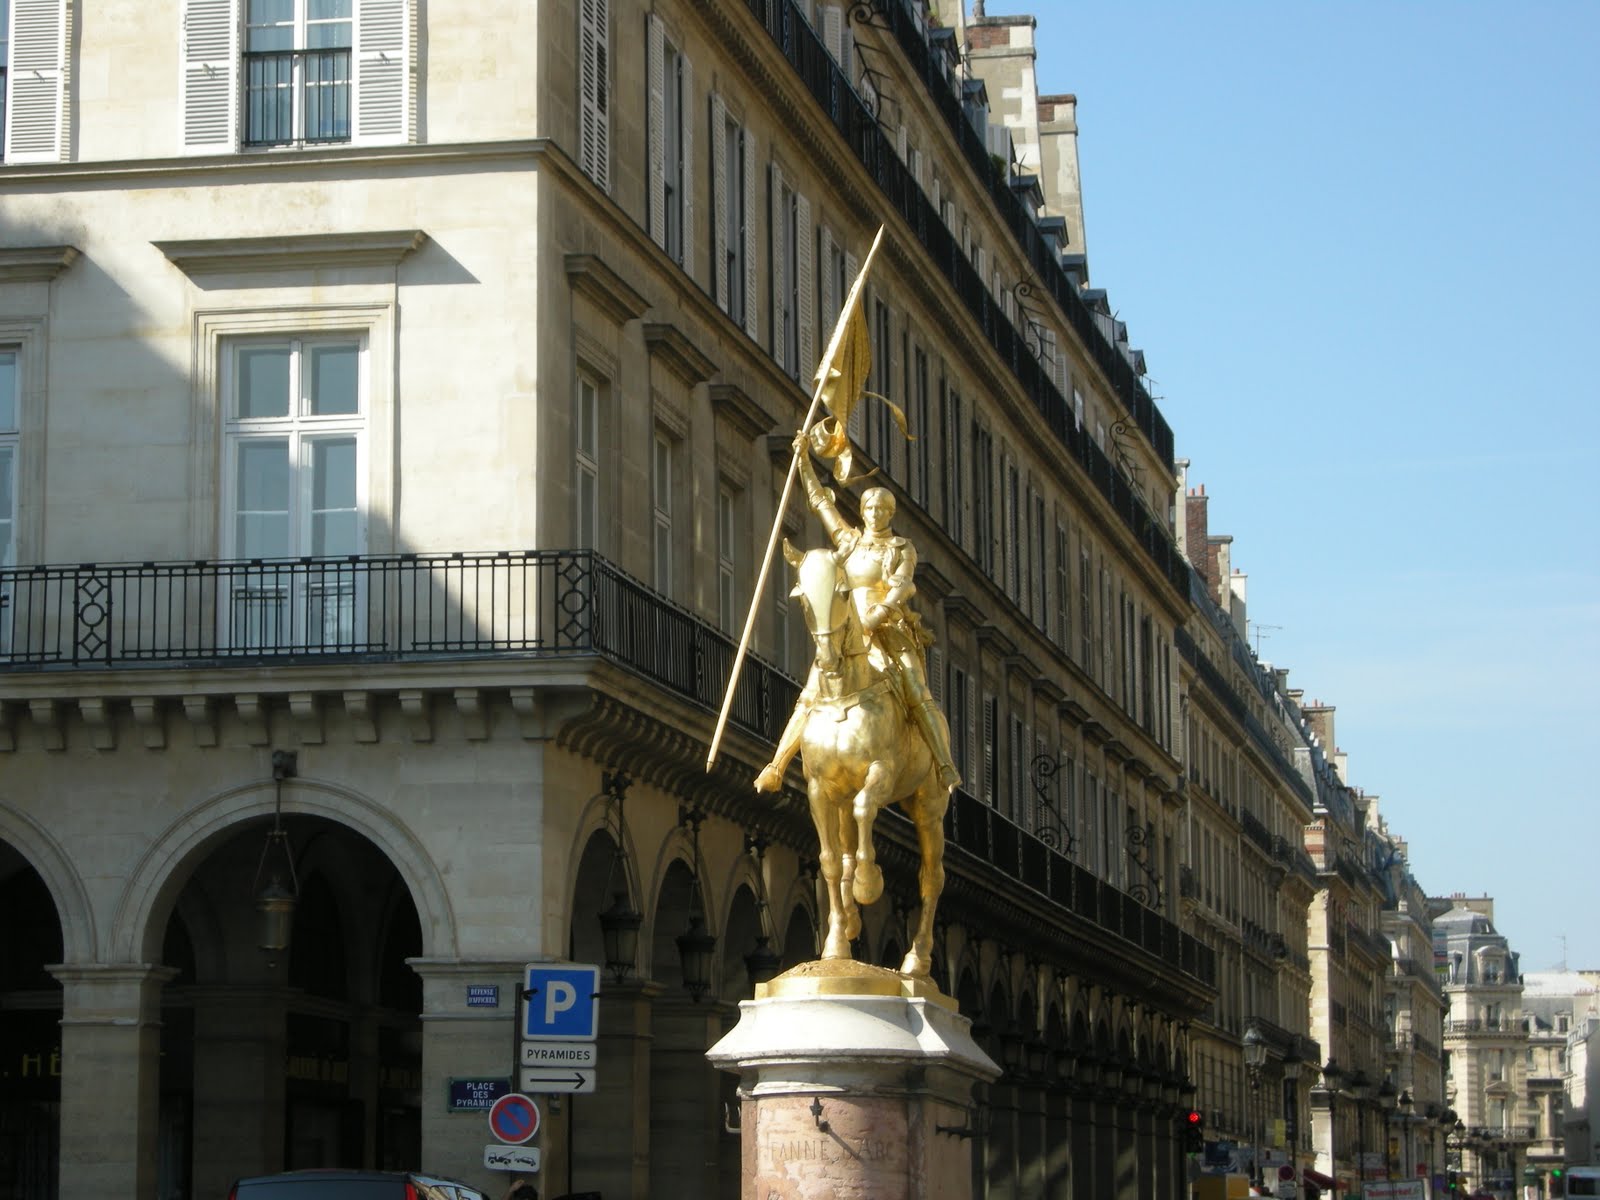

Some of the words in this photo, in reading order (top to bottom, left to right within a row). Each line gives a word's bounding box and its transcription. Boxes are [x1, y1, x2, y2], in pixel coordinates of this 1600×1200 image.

[545, 980, 577, 1024] P
[527, 1049, 590, 1061] PYRAMIDES
[466, 1082, 495, 1091] PLACE
[473, 1090, 489, 1099] DES
[456, 1098, 498, 1108] PYRAMID
